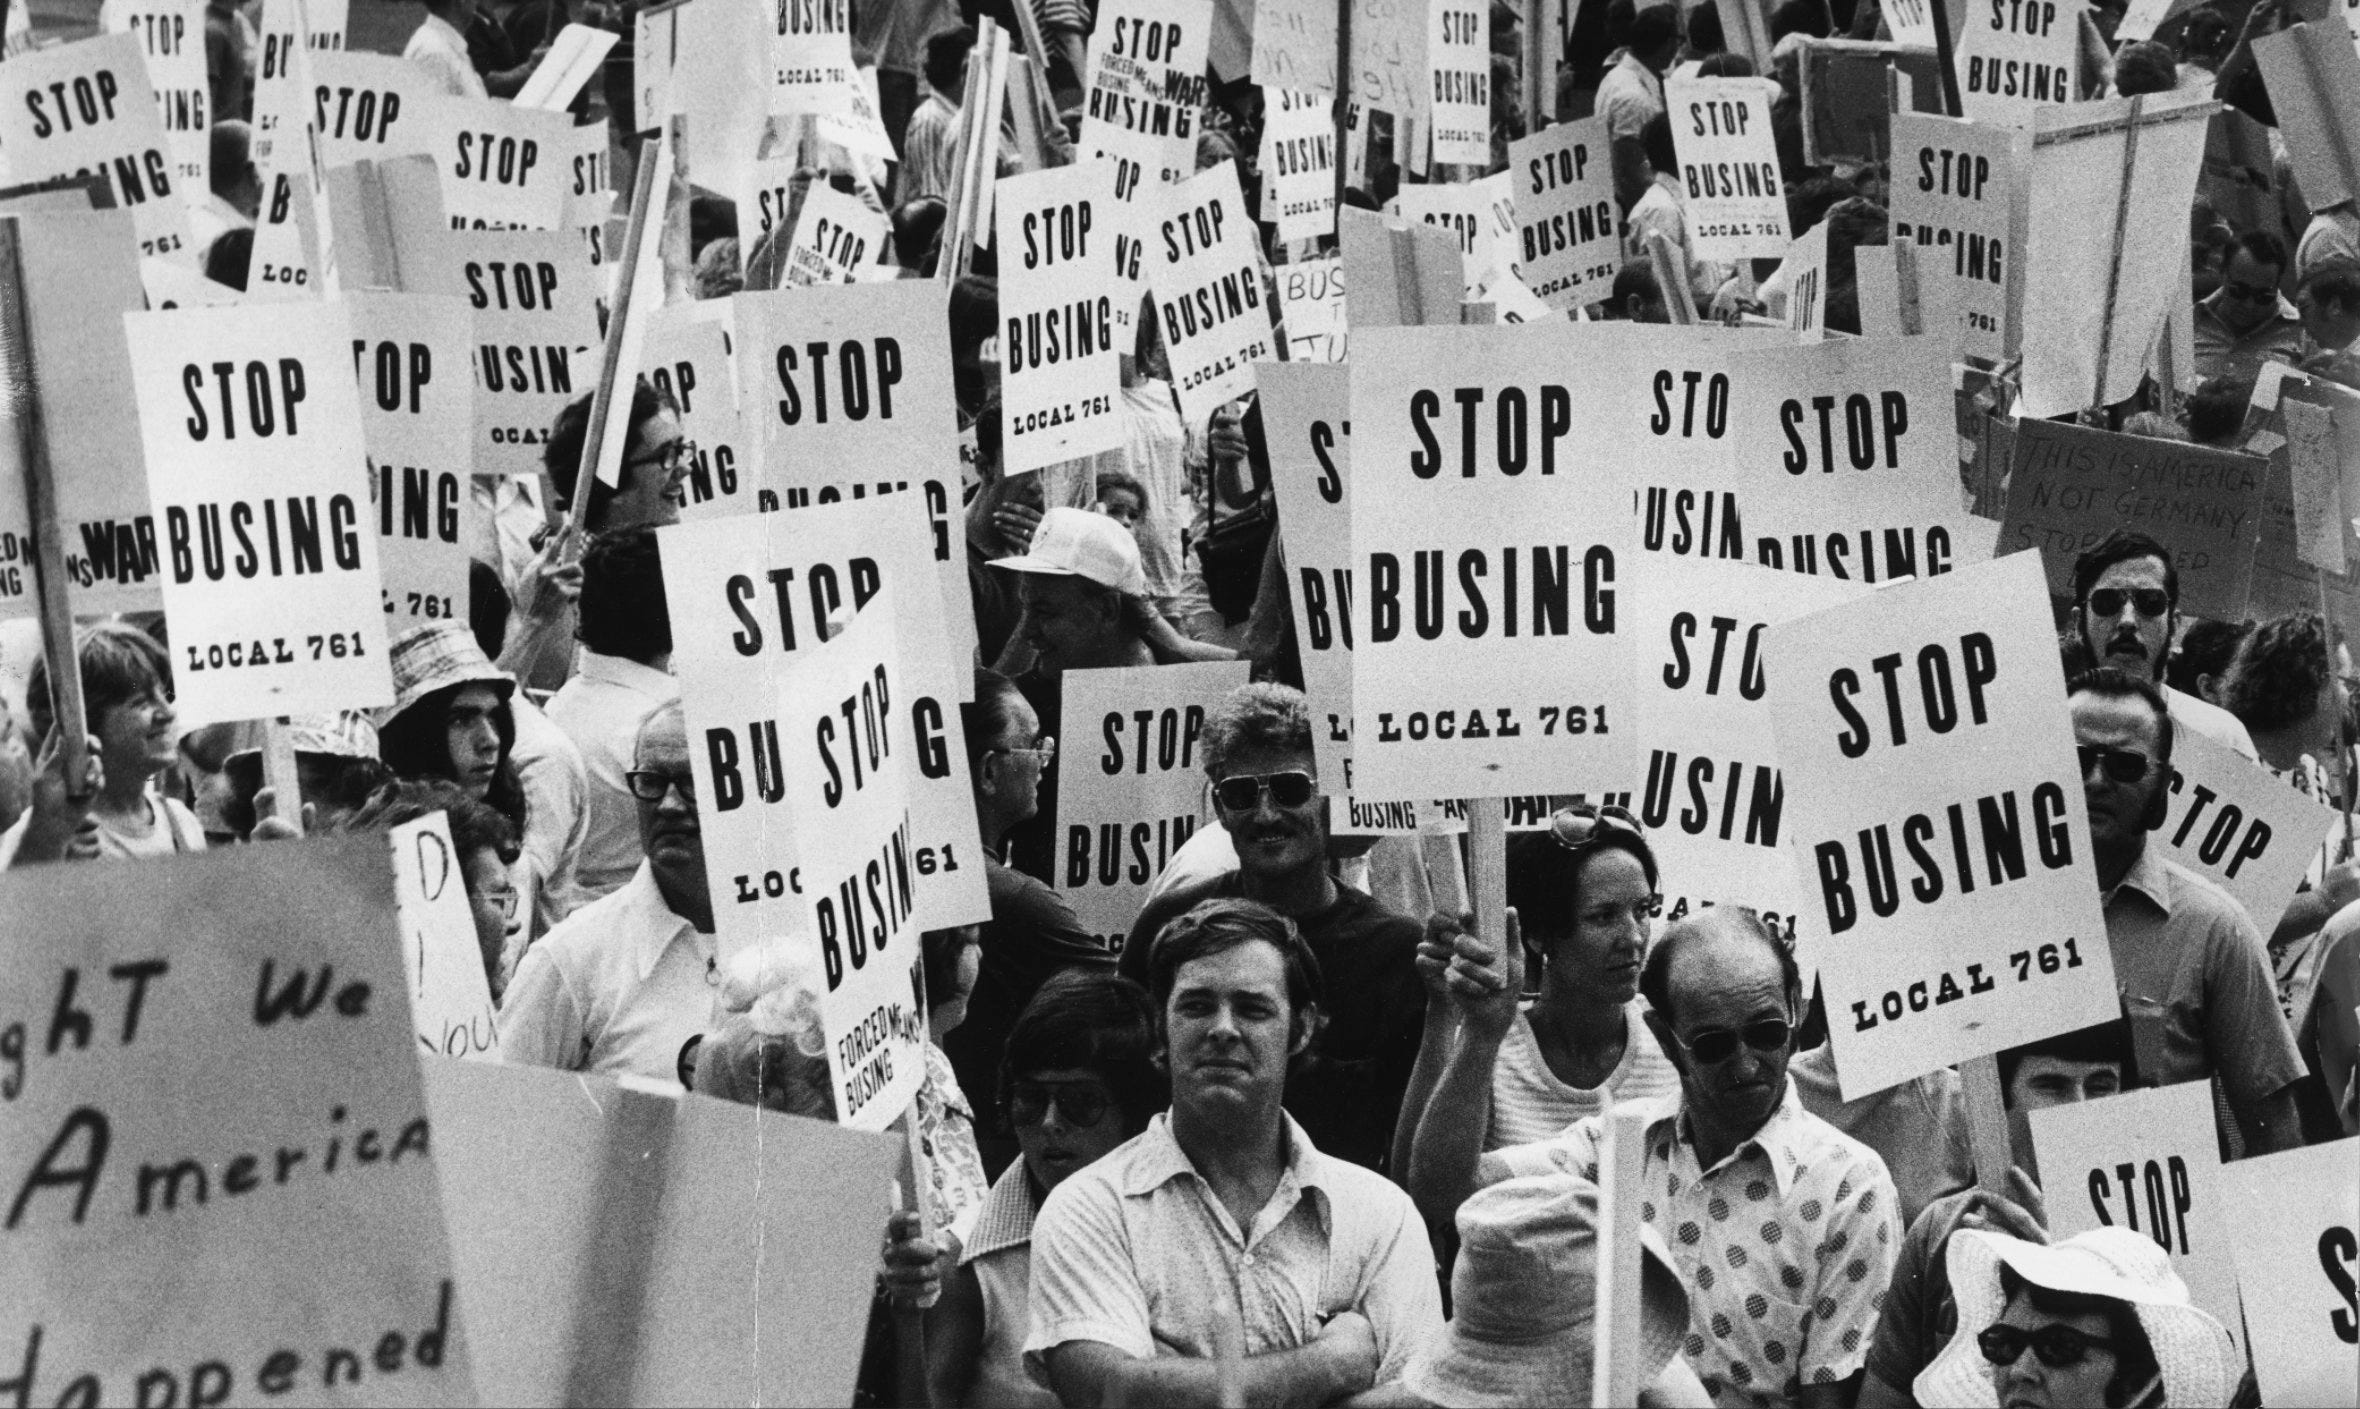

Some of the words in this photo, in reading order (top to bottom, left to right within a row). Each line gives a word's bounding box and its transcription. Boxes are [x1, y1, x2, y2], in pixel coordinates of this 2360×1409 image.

[777, 0, 845, 35] BUSING
[1112, 16, 1182, 64] STOP
[1442, 10, 1478, 45] STOP
[1991, 0, 2056, 37] STOP
[26, 70, 118, 138] STOP
[778, 67, 822, 85] LOCAL
[1165, 68, 1206, 107] WAR
[1434, 69, 1487, 106] BUSING
[1968, 55, 2068, 103] BUSING
[156, 89, 204, 131] ING
[315, 86, 400, 143] STOP
[1438, 128, 1469, 142] LOCAL
[1690, 101, 1749, 136] STOP
[456, 131, 538, 187] STOP
[573, 153, 597, 196] ST
[1530, 143, 1588, 195] STOP
[1685, 162, 1777, 199] BUSING
[1919, 147, 1990, 201] STOP
[759, 187, 785, 231] ST
[1023, 200, 1092, 270] STOP
[1162, 199, 1224, 263] STOP
[1284, 199, 1321, 216] LOCAL
[1522, 201, 1611, 262] BUSING
[1699, 223, 1751, 237] LOCAL
[1757, 224, 1781, 236] 761
[142, 234, 183, 256] 761
[813, 217, 865, 272] STOP
[263, 264, 307, 285] LOC
[465, 262, 557, 311] STOP
[1532, 272, 1583, 298] LOCAL
[1587, 263, 1614, 282] 761
[1163, 266, 1259, 345] BUSING
[1969, 312, 1996, 332] 761
[1008, 296, 1111, 374] BUSING
[476, 346, 586, 393] USIN
[777, 337, 902, 425] STOP
[1183, 356, 1236, 390] LOCAL
[1240, 341, 1266, 366] 761
[183, 358, 306, 441] STOP
[1013, 403, 1075, 435] LOCAL
[1082, 395, 1112, 418] 761
[1651, 369, 1729, 438] STO
[491, 427, 550, 443] OCAL
[1410, 384, 1571, 479] STOP
[1780, 391, 1909, 475] STOP
[2024, 436, 2095, 473] THIS
[2138, 456, 2256, 491] AMERICA
[381, 466, 458, 543] ING
[1636, 486, 1743, 560] USIN
[2032, 481, 2105, 510] NOT
[2114, 489, 2247, 538] GERMANY
[80, 516, 160, 584] WAR
[167, 494, 360, 583] BUSING
[407, 592, 453, 618] 761
[726, 557, 882, 657] STOP
[1370, 544, 1616, 643] BUSING
[188, 638, 293, 671] LOCAL
[308, 631, 366, 660] 761
[1663, 611, 1768, 701] STO
[1829, 631, 1997, 759] STOP
[817, 663, 891, 809] STOP
[1102, 705, 1205, 775] STOP
[1378, 708, 1520, 742] LOCAL
[1539, 705, 1609, 735] 761
[1642, 750, 1784, 848] USIN
[734, 866, 803, 903] LOC
[915, 843, 958, 875] 61
[1067, 814, 1194, 887] BUSIN
[1814, 781, 2073, 935] BUSING
[816, 812, 913, 992] BUSIN
[251, 957, 374, 1028] We
[1852, 963, 1995, 1032] LOCAL
[2010, 938, 2083, 982] 761
[839, 1005, 887, 1074] FORCED
[846, 1048, 893, 1117] BUSING
[2088, 1155, 2190, 1256] STOP
